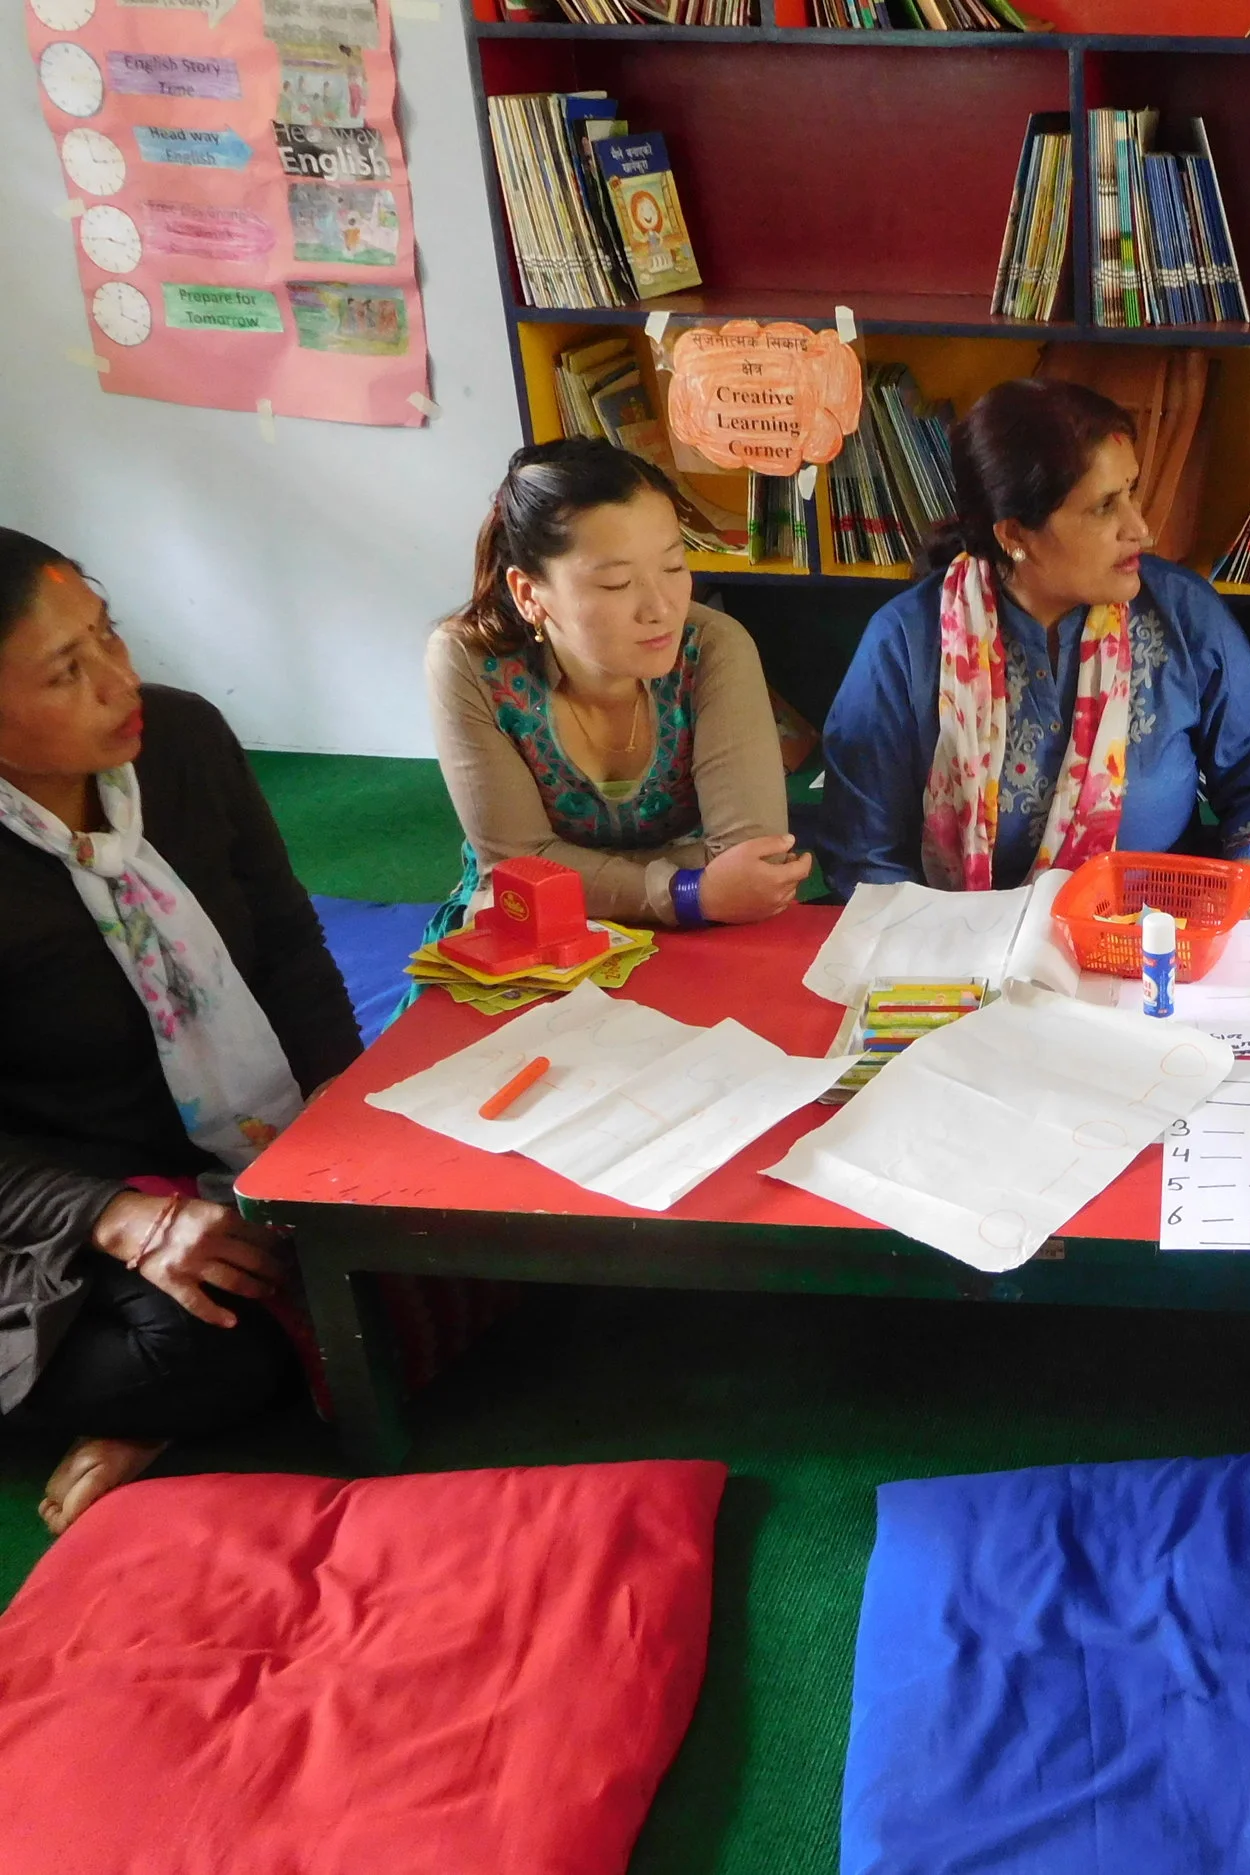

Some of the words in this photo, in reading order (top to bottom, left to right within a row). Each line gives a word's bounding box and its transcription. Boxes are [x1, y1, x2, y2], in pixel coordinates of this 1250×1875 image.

[123, 54, 179, 75] English
[181, 58, 221, 77] Story
[147, 126, 187, 141] Head
[165, 148, 217, 166] English
[278, 144, 391, 182] English
[178, 287, 233, 305] Prepare
[235, 291, 257, 306] for
[741, 359, 763, 376] क्षेत्र
[716, 386, 794, 406] Creative
[717, 413, 801, 437] Learning
[728, 440, 793, 459] Corner
[1169, 1118, 1191, 1137] 3
[1171, 1146, 1190, 1163] 4
[1167, 1176, 1191, 1192] 5
[1166, 1205, 1184, 1226] 6
